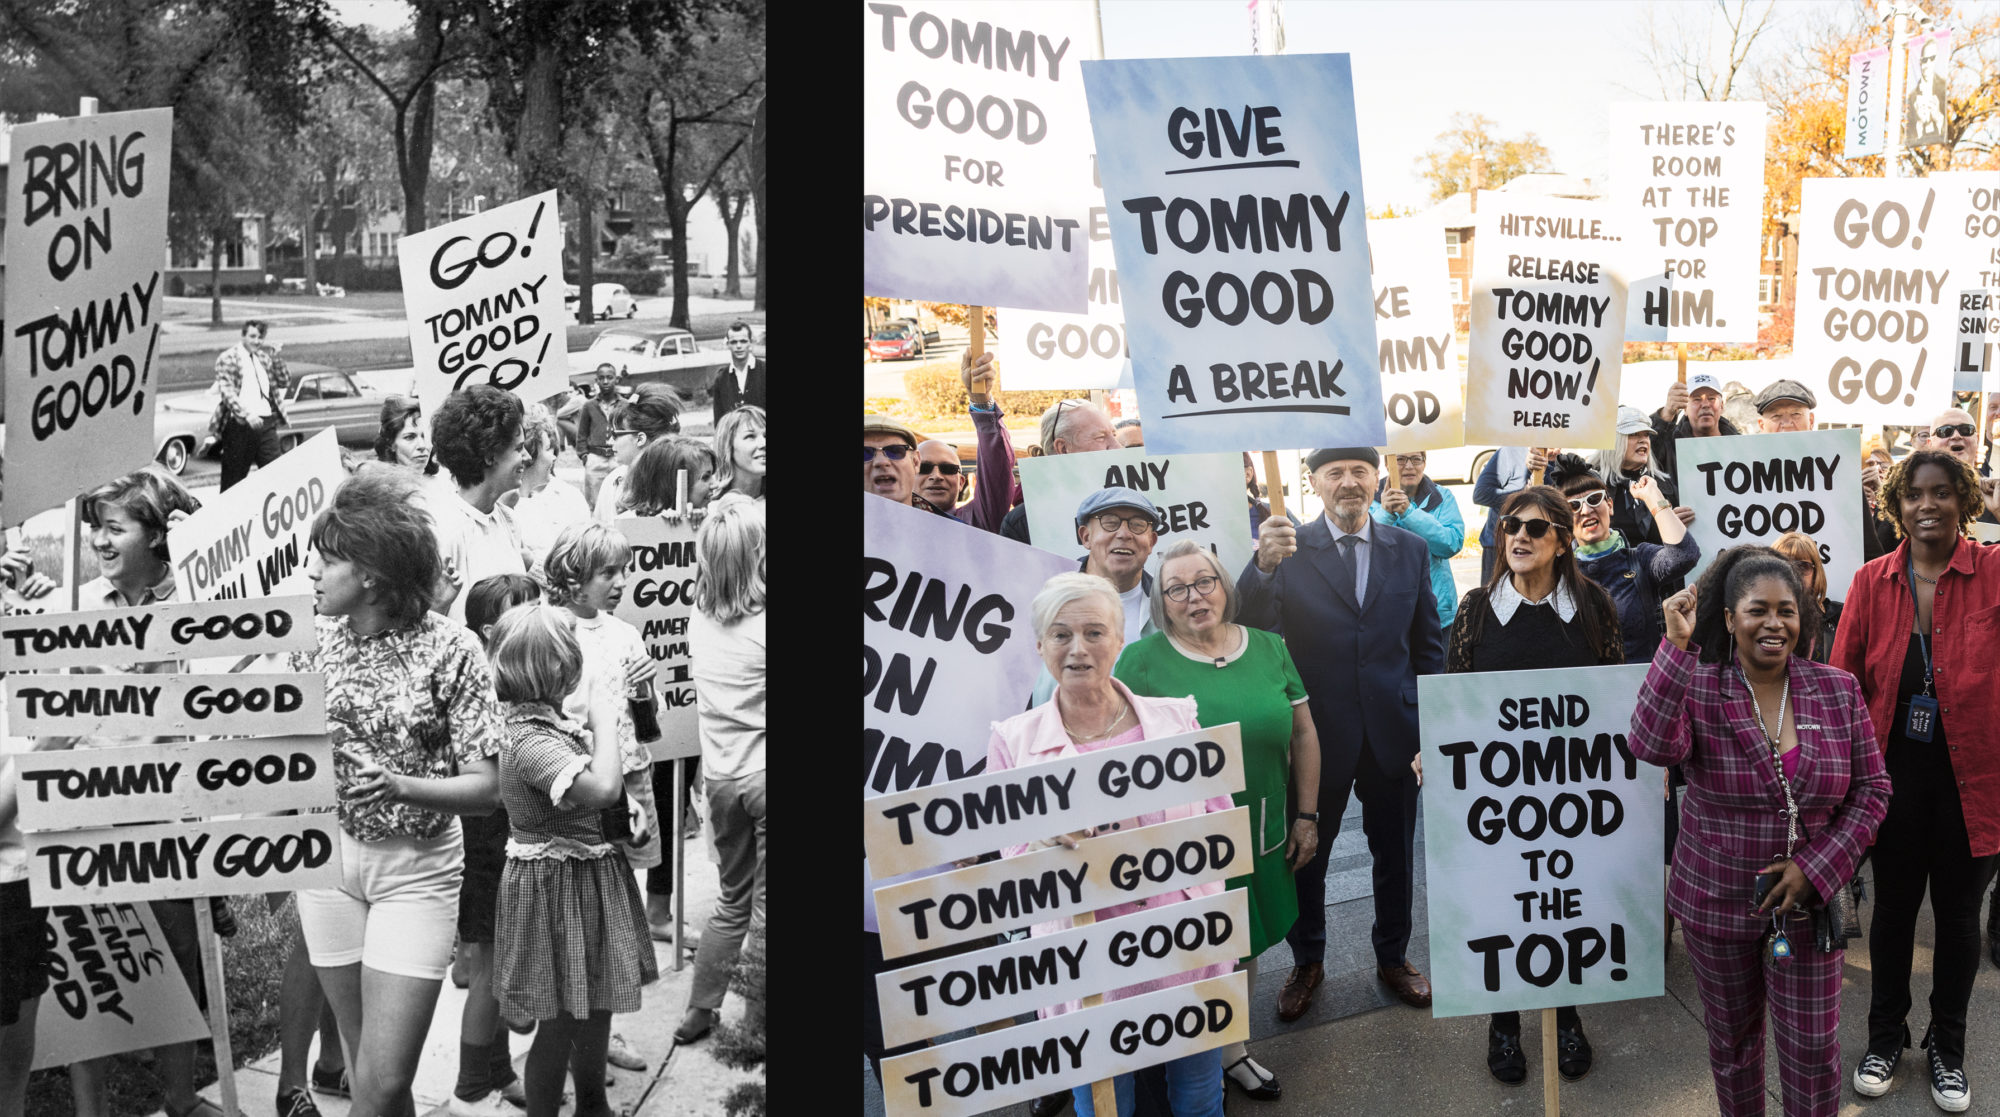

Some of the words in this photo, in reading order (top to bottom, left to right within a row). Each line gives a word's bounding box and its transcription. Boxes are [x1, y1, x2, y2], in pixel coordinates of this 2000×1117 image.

[867, 2, 1070, 82] TOMMY
[896, 80, 1047, 145] GOOD
[1858, 60, 1871, 146] MOTOWN
[1167, 104, 1285, 160] GIVE
[1640, 121, 1736, 147] THERE'S
[23, 131, 146, 227] BRING
[944, 155, 1005, 187] FOR
[1652, 156, 1722, 177] ROOM
[864, 194, 1080, 252] PRESIDENT
[1122, 191, 1350, 255] TOMMY
[1642, 186, 1673, 208] AT
[1687, 186, 1730, 208] THE
[1833, 187, 1936, 250] GO!
[48, 207, 112, 282] ON
[429, 201, 546, 290] GO!
[1500, 213, 1622, 242] HITSVILLE...
[1653, 217, 1718, 247] TOP
[1507, 254, 1600, 284] RELEASE
[1664, 258, 1706, 280] FOR
[1812, 266, 1950, 305] TOMMY
[15, 271, 160, 378] TOMMY
[424, 274, 548, 344] TOMMY
[1161, 269, 1334, 328] GOOD
[1491, 288, 1611, 328] TOMMY
[1643, 286, 1727, 328] HIM.
[438, 314, 540, 374] GOOD
[1027, 322, 1130, 361] GOO
[1502, 327, 1593, 365] GOOD
[1823, 307, 1929, 345] GOOD
[31, 323, 159, 441] GOOD!
[1167, 364, 1198, 404] A
[1209, 359, 1347, 403] BREAK
[1507, 357, 1601, 407] NOW!
[1828, 347, 1928, 407] GO!
[1383, 390, 1441, 427] OD
[1513, 410, 1570, 429] PLEASE
[1104, 459, 1170, 492] ANY
[1696, 453, 1841, 497] TOMMY
[178, 519, 252, 601] TOMMY
[262, 477, 324, 540] GOOD
[1717, 500, 1825, 539] GOOD
[2, 613, 154, 656] TOMMY
[171, 609, 293, 645] GOOD
[16, 685, 162, 719] TOMMY
[183, 683, 303, 720] GOOD
[1498, 694, 1590, 731] SEND
[22, 762, 182, 802] TOMMY
[197, 753, 316, 790] GOOD
[1438, 733, 1637, 790] TOMMY
[882, 768, 1077, 845] TOMMY
[1098, 741, 1226, 798] GOOD
[1467, 789, 1624, 845] GOOD
[36, 832, 210, 889] TOMMY
[213, 828, 332, 878] GOOD
[1521, 849, 1574, 882] TO
[899, 862, 1089, 939] TOMMY
[1109, 834, 1236, 891] GOOD
[1514, 887, 1582, 922] THE
[91, 903, 140, 984] END
[113, 902, 164, 976] ET'S
[899, 939, 1088, 1016] TOMMY
[1108, 911, 1233, 967] GOOD
[1467, 923, 1628, 992] TOP!
[904, 1028, 1090, 1107] TOMMY
[1109, 998, 1233, 1055] GOOD
